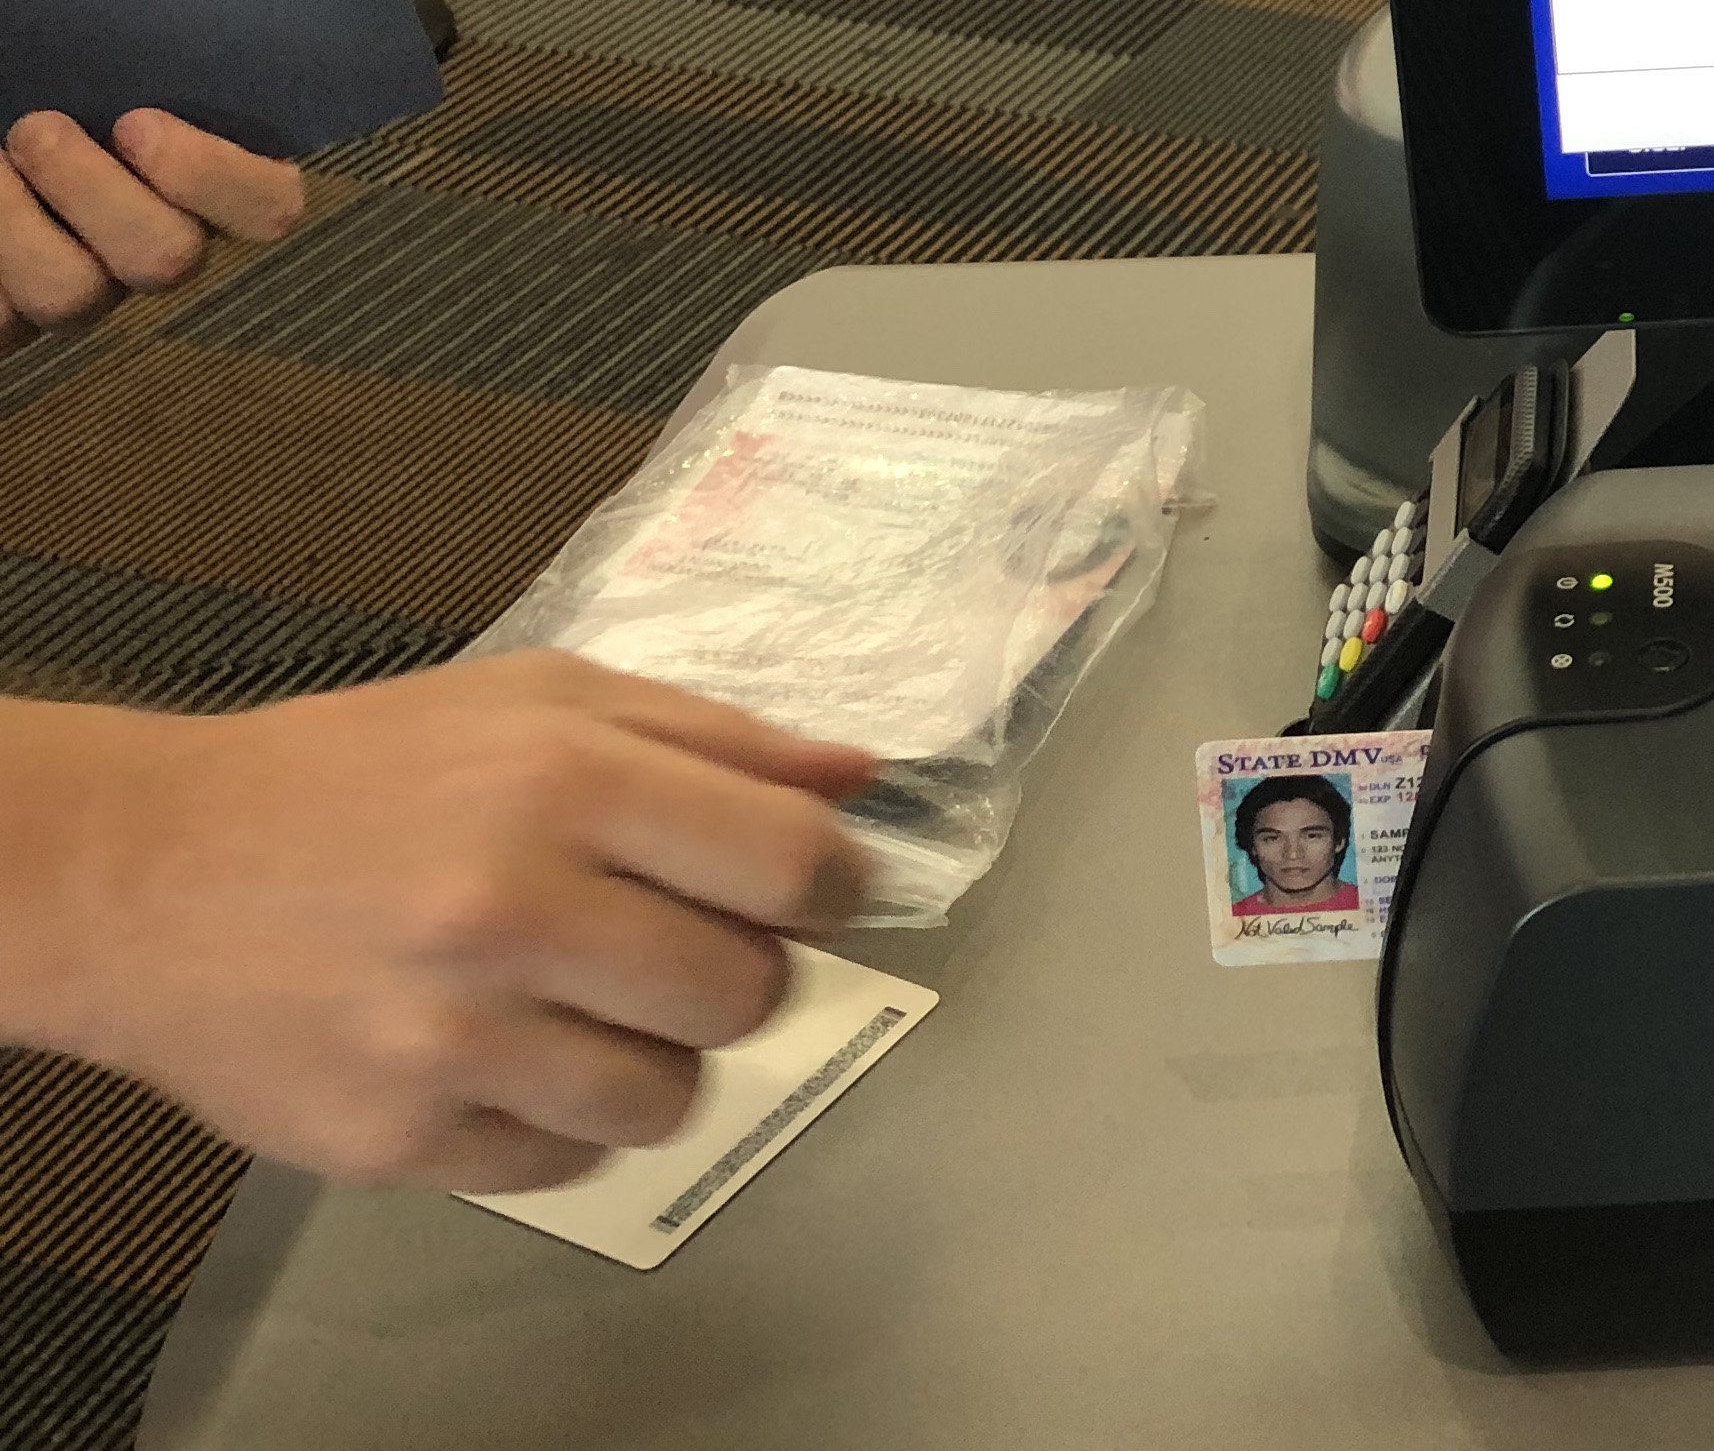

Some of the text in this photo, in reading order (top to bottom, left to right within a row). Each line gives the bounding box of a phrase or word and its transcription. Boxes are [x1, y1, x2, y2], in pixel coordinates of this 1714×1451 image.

[1652, 563, 1675, 609] M500
[1217, 752, 1303, 775] STATE
[1310, 747, 1383, 769] DMV
